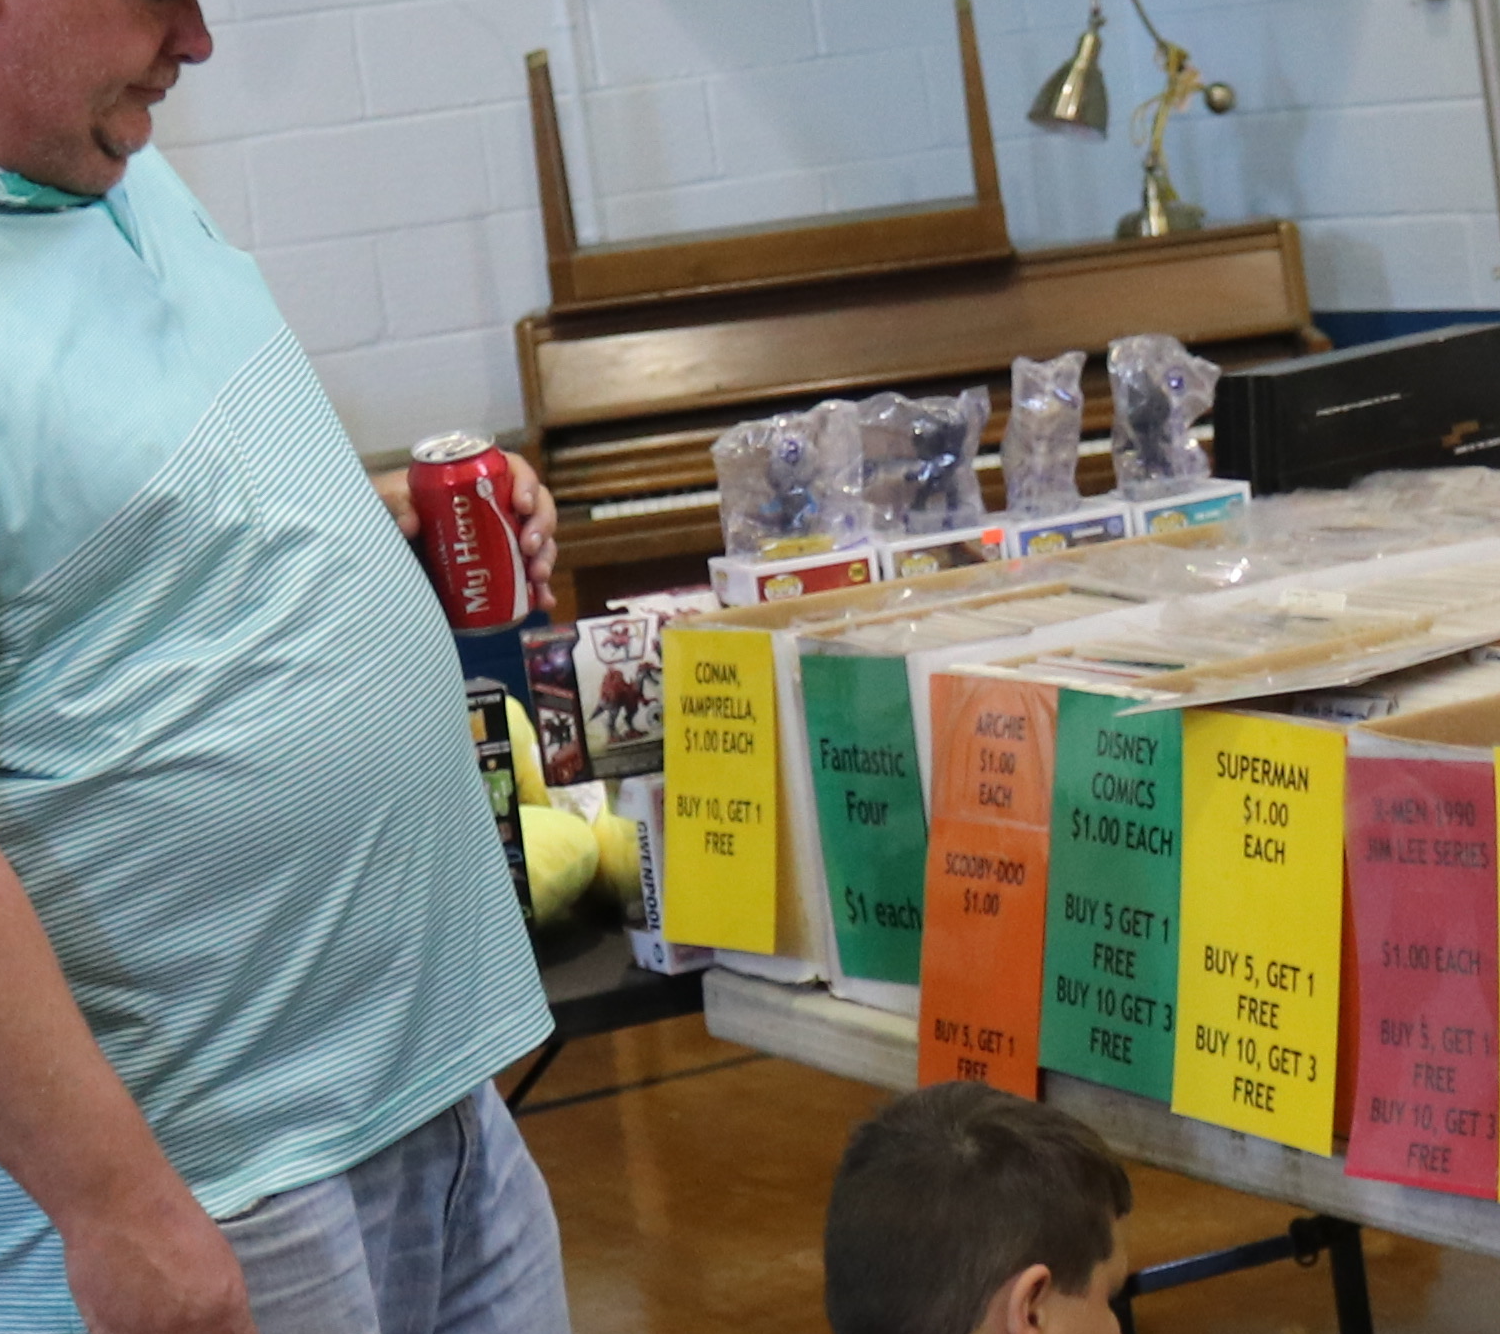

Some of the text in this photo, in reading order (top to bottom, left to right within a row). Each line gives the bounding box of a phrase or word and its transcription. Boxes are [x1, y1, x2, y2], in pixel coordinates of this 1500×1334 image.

[452, 494, 491, 614] My Hero
[695, 662, 741, 688] CONAN,
[680, 695, 757, 726] VAMPIRELLA,
[975, 712, 1026, 741] ARCHIE
[684, 730, 754, 755] $1.00 EACH
[820, 738, 906, 778] Fantastic
[1098, 729, 1158, 766] DISNEY
[980, 748, 1015, 775] $1.00
[1217, 751, 1309, 793] SUPERMAN
[845, 791, 888, 826] Four
[978, 784, 1013, 808] EACH
[1092, 772, 1156, 810] COMICS
[1243, 795, 1289, 827] $1.00
[1372, 797, 1476, 828] X-MEN 1990
[1071, 810, 1173, 856] $1.00 EACH
[1244, 834, 1285, 864] EACH
[946, 852, 1025, 885] SCOOBY-DOO
[1366, 835, 1488, 869] JIM LEE SERIES
[844, 886, 922, 930] $1 each
[963, 888, 1000, 917] $1.00
[1204, 945, 1314, 997] BUY 5, GET 1
[1382, 940, 1481, 976] $1.00 EACH
[1237, 995, 1280, 1030] FREE
[1195, 1024, 1317, 1082] BUY 10, GET 3
[1233, 1076, 1276, 1113] FREE
